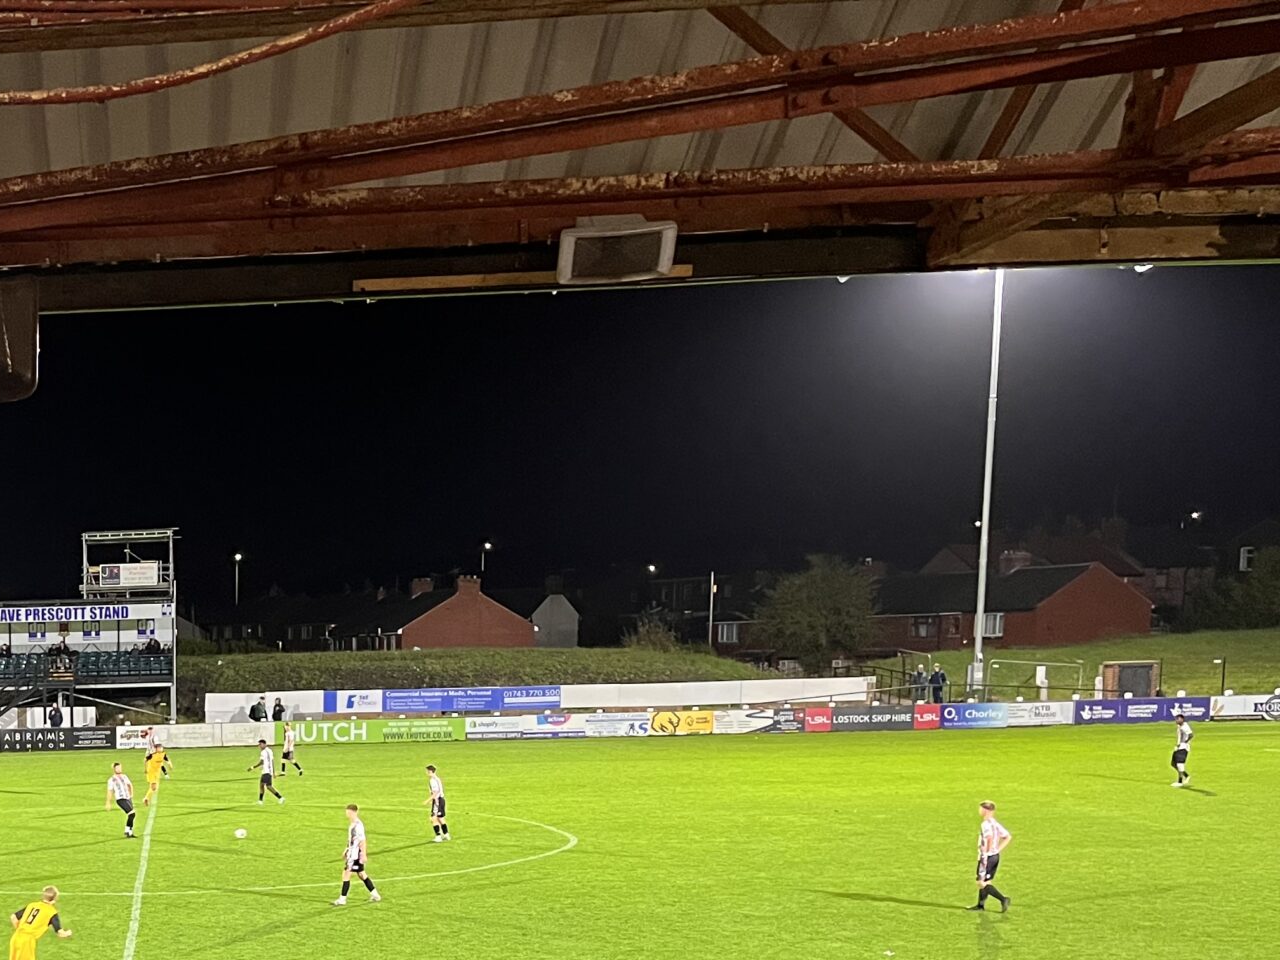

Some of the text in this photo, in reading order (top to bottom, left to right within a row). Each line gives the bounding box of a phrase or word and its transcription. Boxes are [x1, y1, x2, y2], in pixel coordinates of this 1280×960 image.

[24, 607, 87, 621] PRESCOTT
[89, 605, 129, 620] STAND
[545, 688, 560, 696] 500
[833, 713, 912, 723] LOSTOCK SKIP HIRE
[965, 709, 1003, 719] Chorley
[4, 731, 65, 741] ABRAMS
[26, 907, 40, 925] 19
